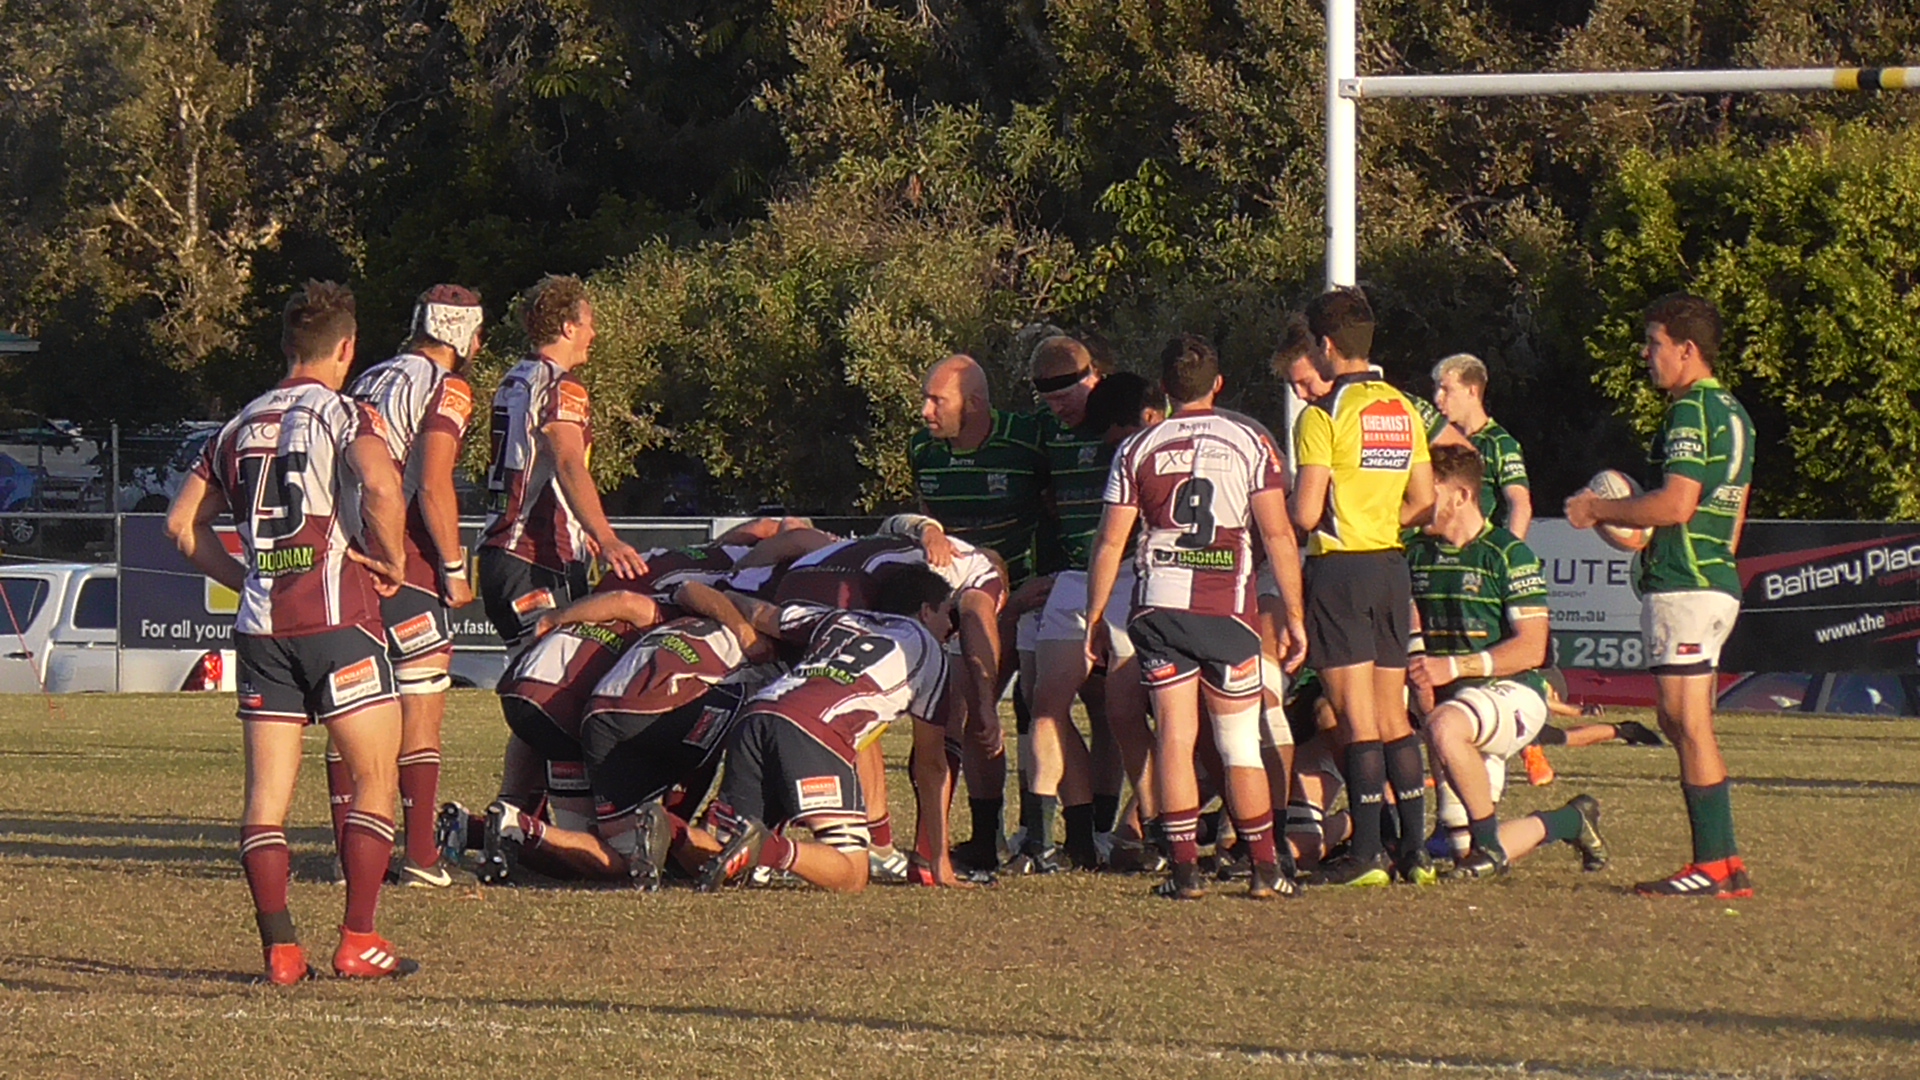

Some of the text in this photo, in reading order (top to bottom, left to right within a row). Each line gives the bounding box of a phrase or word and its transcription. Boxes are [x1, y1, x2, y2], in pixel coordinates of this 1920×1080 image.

[1362, 415, 1409, 431] CHEMIST
[1362, 449, 1411, 458] DISCOUNT
[1362, 458, 1406, 467] CHEMIST
[236, 451, 308, 541] 15
[1170, 476, 1216, 550] 9
[257, 546, 314, 571] DOONAN
[1178, 551, 1234, 565] DOONAN
[1539, 558, 1629, 586] UTE
[1765, 560, 1862, 600] Battery
[141, 619, 233, 643] For all your
[806, 624, 896, 679] 19
[1572, 637, 1643, 668] 258
